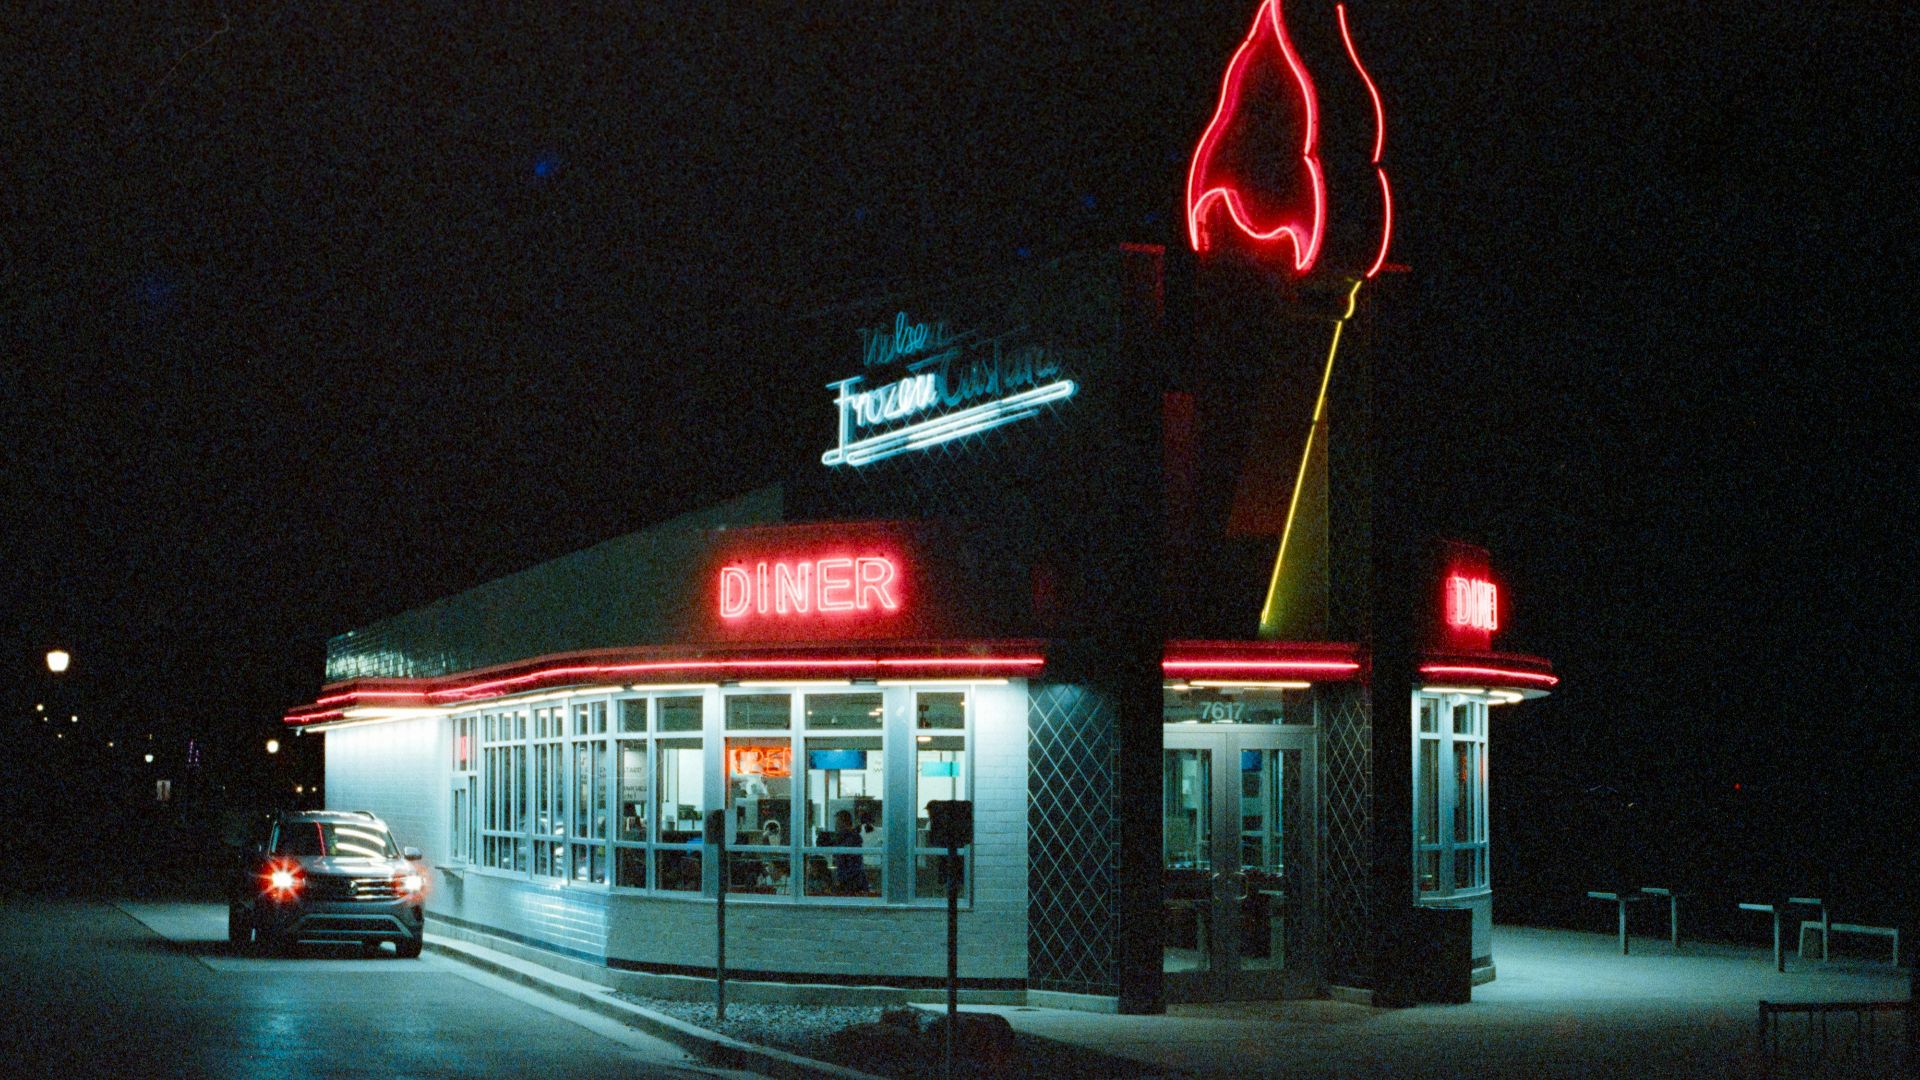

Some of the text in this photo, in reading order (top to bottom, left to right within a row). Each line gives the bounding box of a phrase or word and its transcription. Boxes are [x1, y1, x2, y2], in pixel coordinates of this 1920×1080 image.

[822, 373, 938, 457] Frozen
[720, 557, 898, 619] DINER
[1200, 701, 1246, 720] 7617
